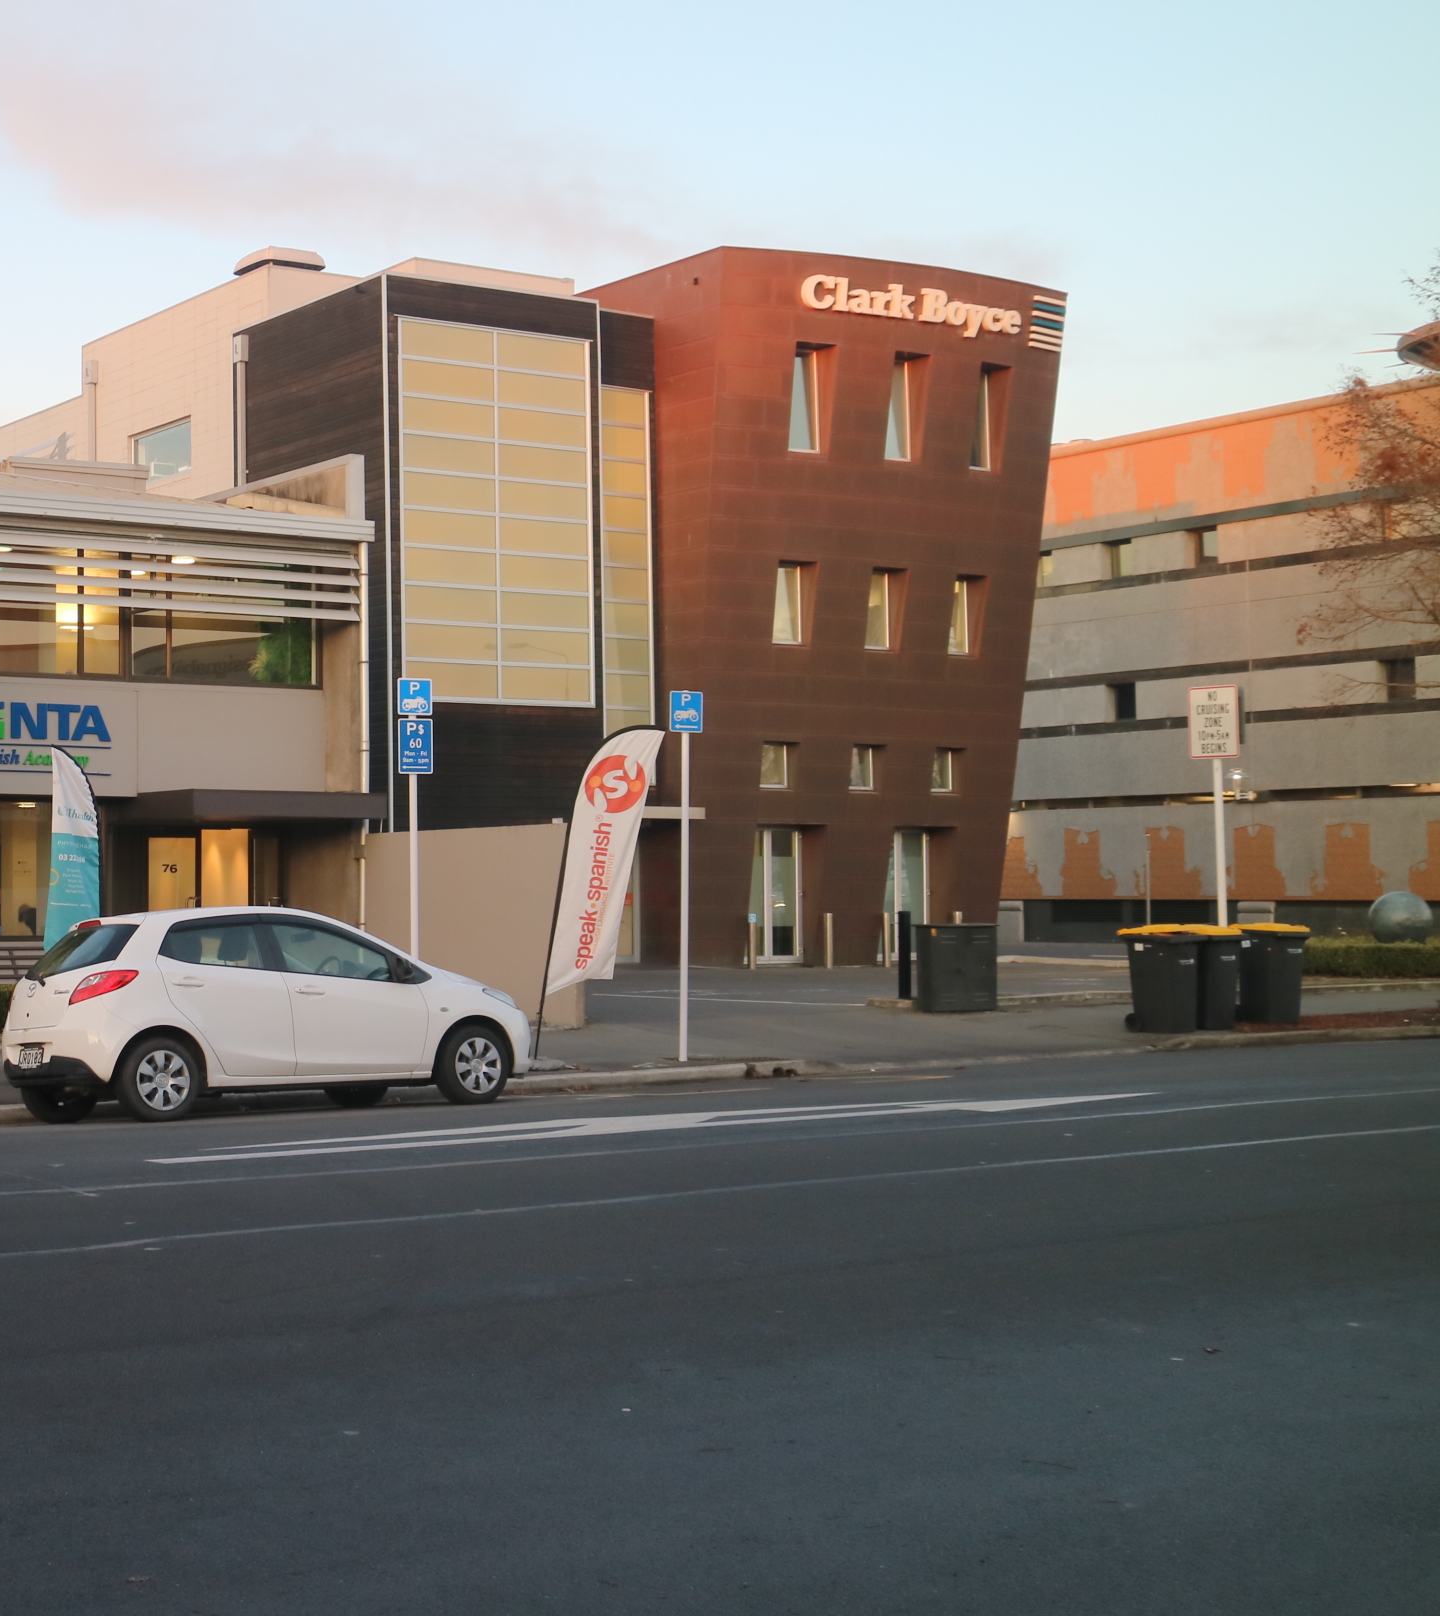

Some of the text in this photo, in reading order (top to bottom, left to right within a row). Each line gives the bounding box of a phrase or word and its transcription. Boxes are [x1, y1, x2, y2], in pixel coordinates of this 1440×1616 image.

[801, 274, 1022, 338] Clark Boyce
[409, 681, 420, 695] P
[681, 694, 691, 706] P
[1207, 691, 1217, 701] NO
[1196, 703, 1229, 715] CRUISING
[10, 701, 111, 742] NTA
[1204, 716, 1222, 728] ZONE
[409, 738, 422, 749] 60
[1201, 742, 1227, 754] BEGINS
[162, 864, 178, 873] 76
[597, 892, 608, 927] LANGUAGE
[604, 853, 615, 886] INSTITUTE
